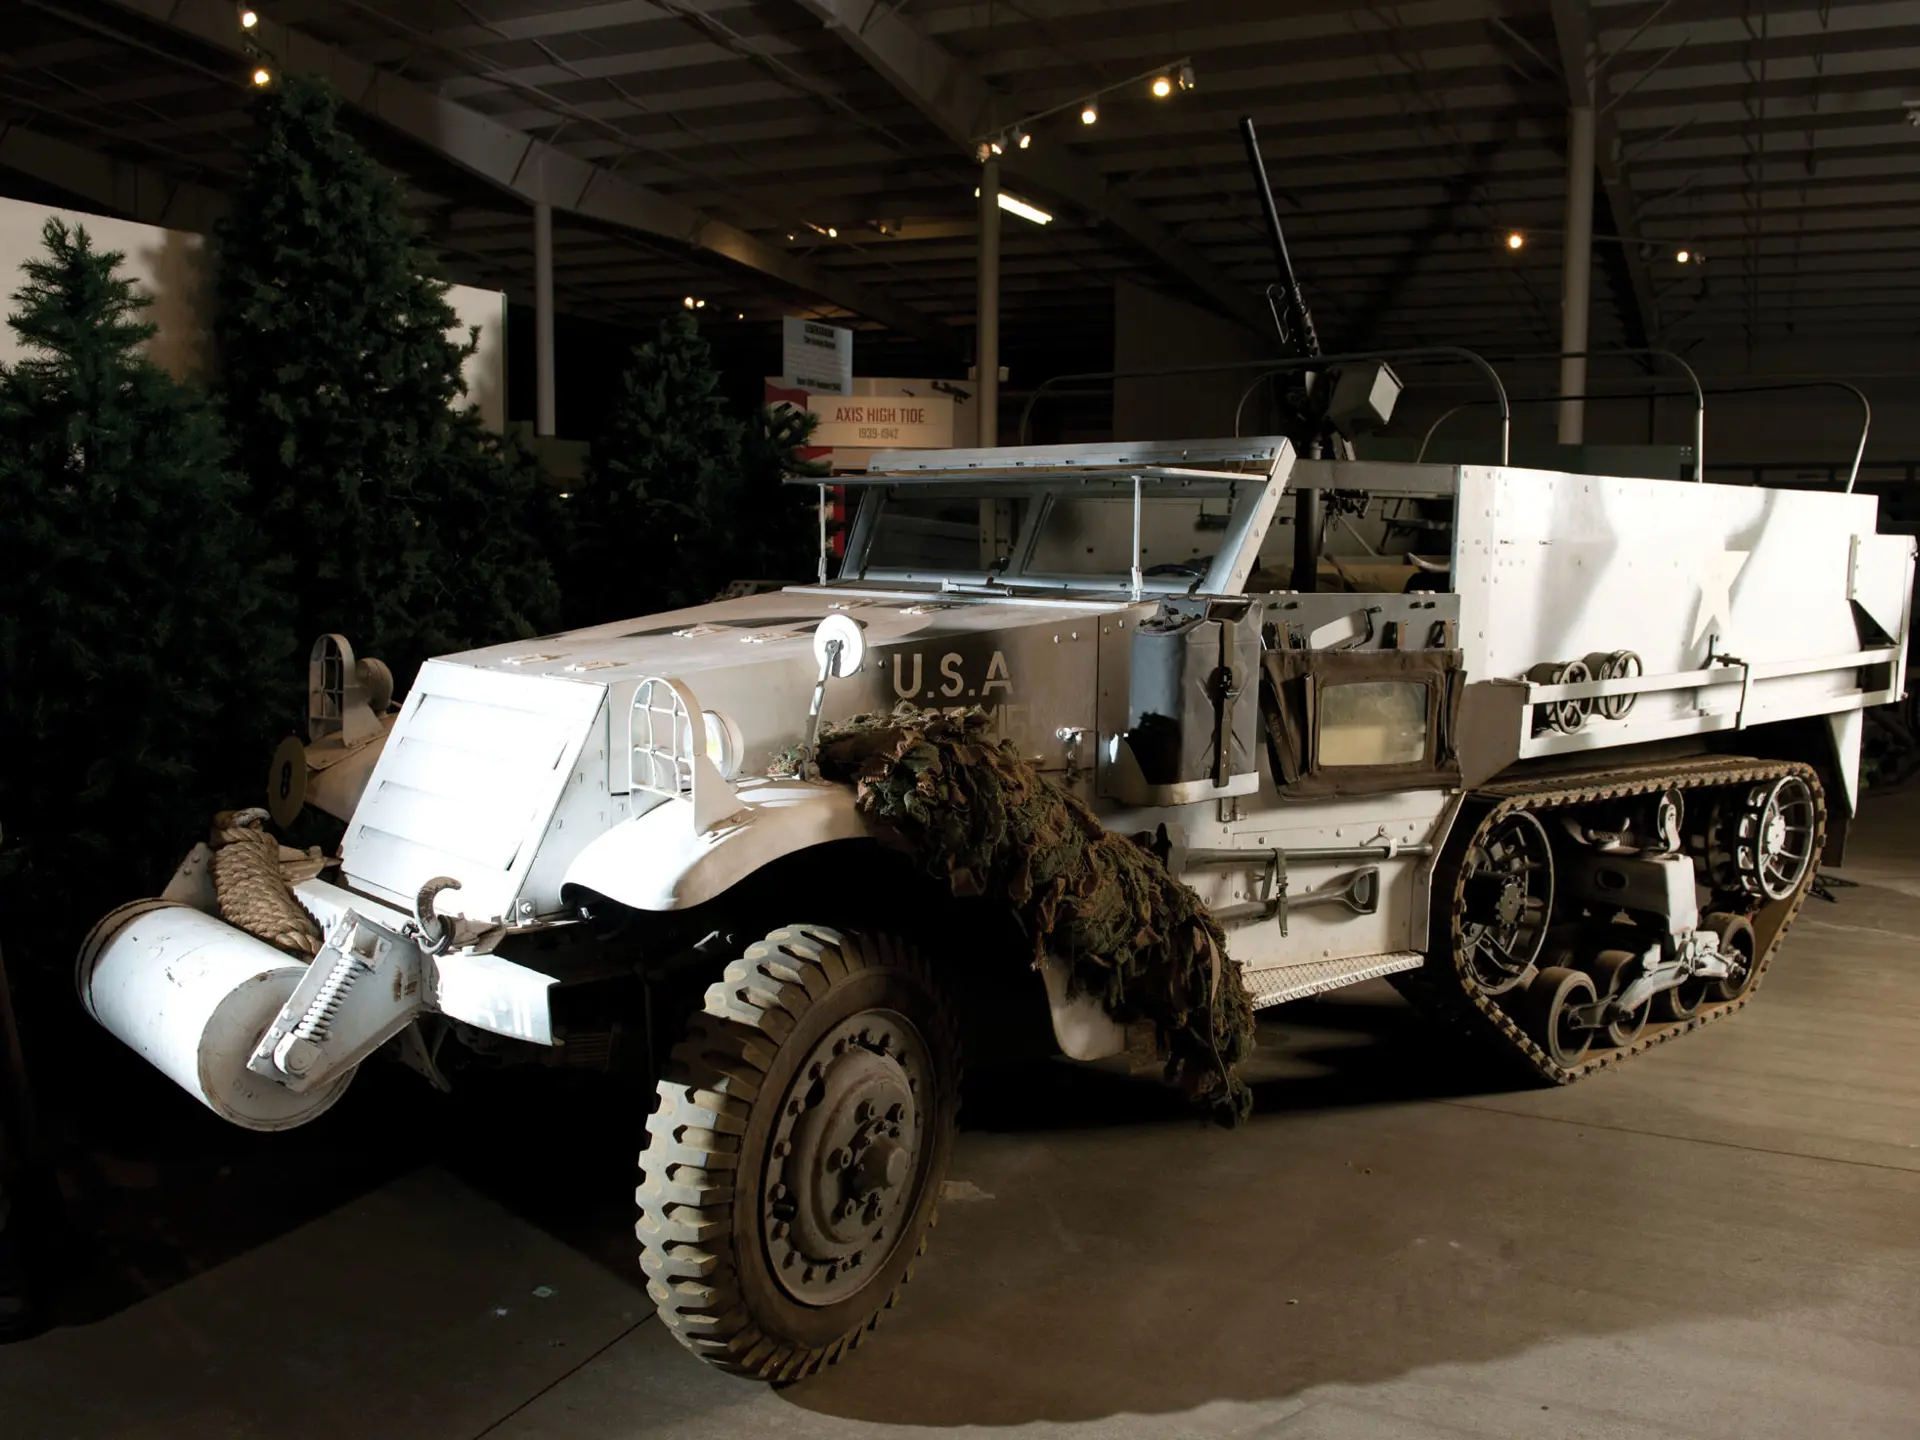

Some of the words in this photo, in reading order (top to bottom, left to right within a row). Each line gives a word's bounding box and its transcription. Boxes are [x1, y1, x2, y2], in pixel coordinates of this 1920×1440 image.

[835, 406, 863, 422] AXIS
[867, 407, 896, 423] HIGH
[900, 408, 925, 423] TIDE
[858, 427, 899, 440] 1939-1942
[893, 651, 1014, 699] U.S.A
